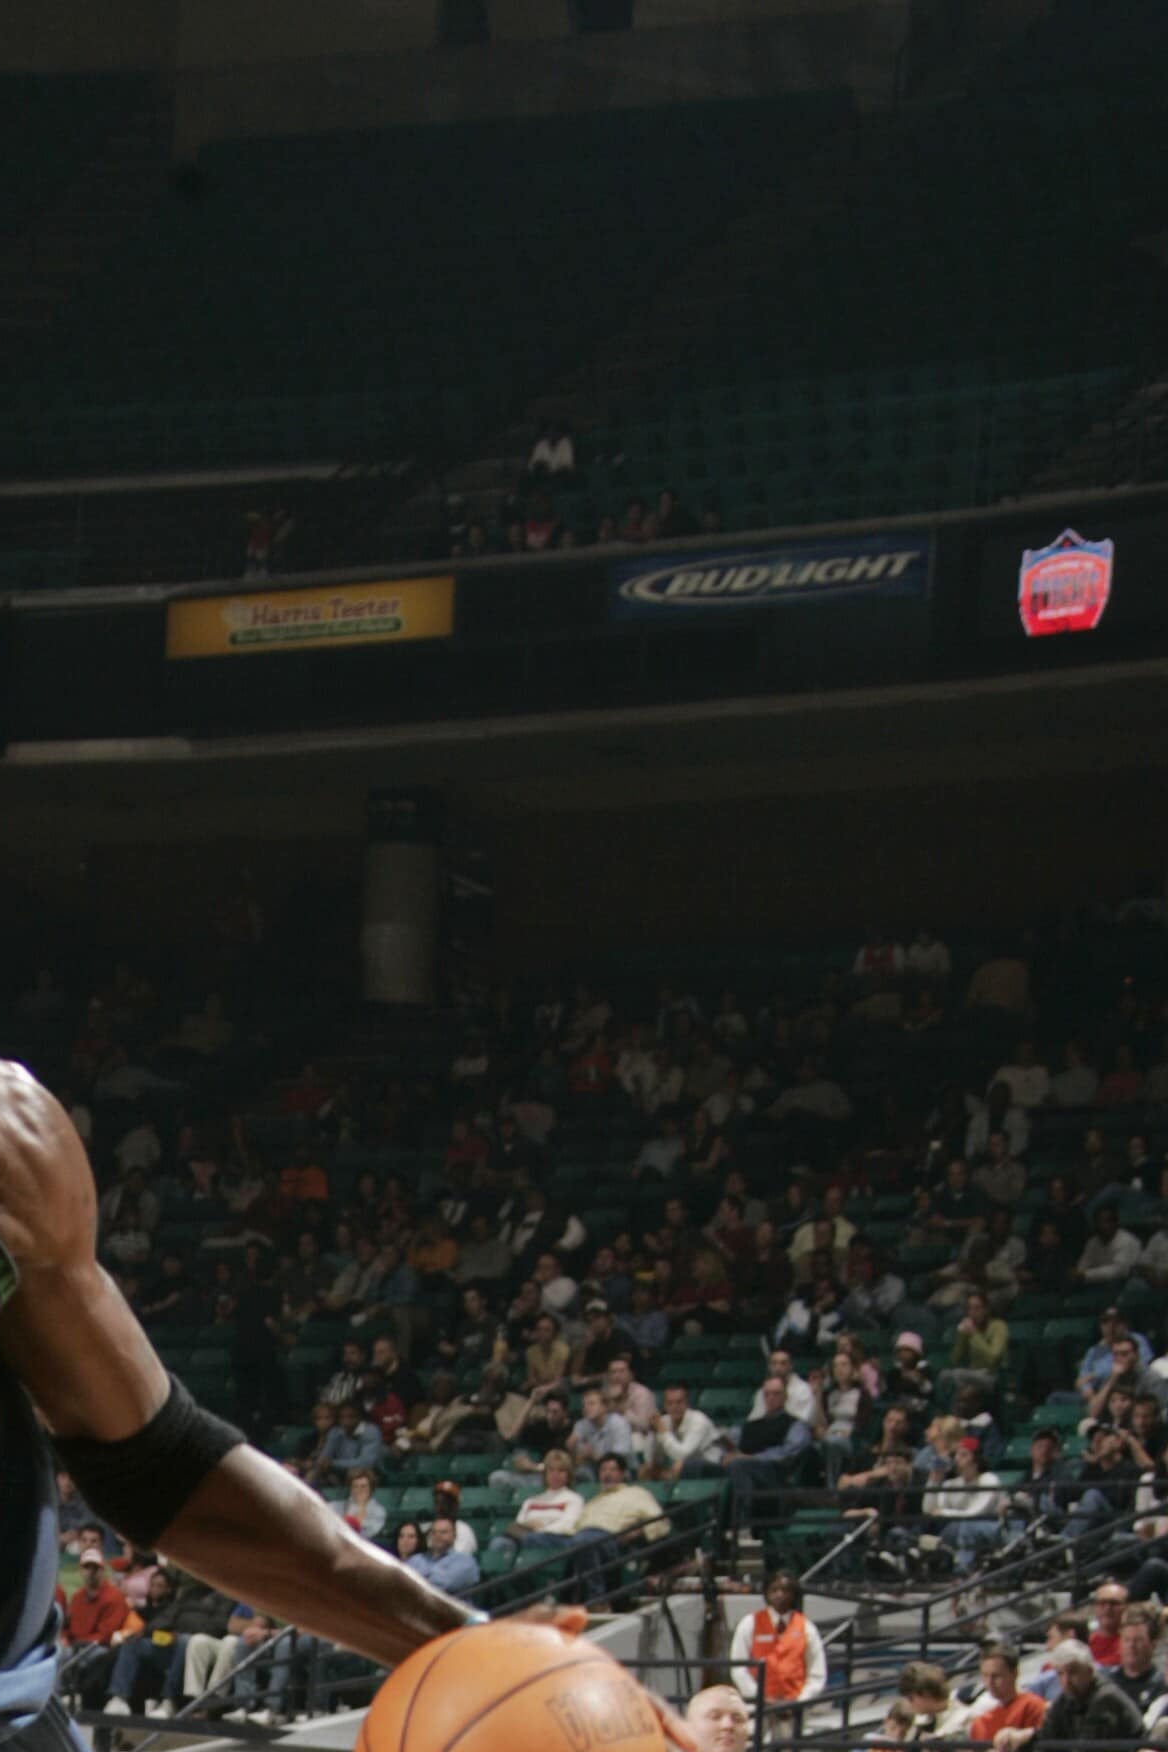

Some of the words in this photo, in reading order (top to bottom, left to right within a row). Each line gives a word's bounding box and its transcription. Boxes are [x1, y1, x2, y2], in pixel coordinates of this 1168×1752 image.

[665, 564, 771, 596] BUD
[770, 550, 920, 588] LIGHT
[329, 597, 402, 618] Teeter
